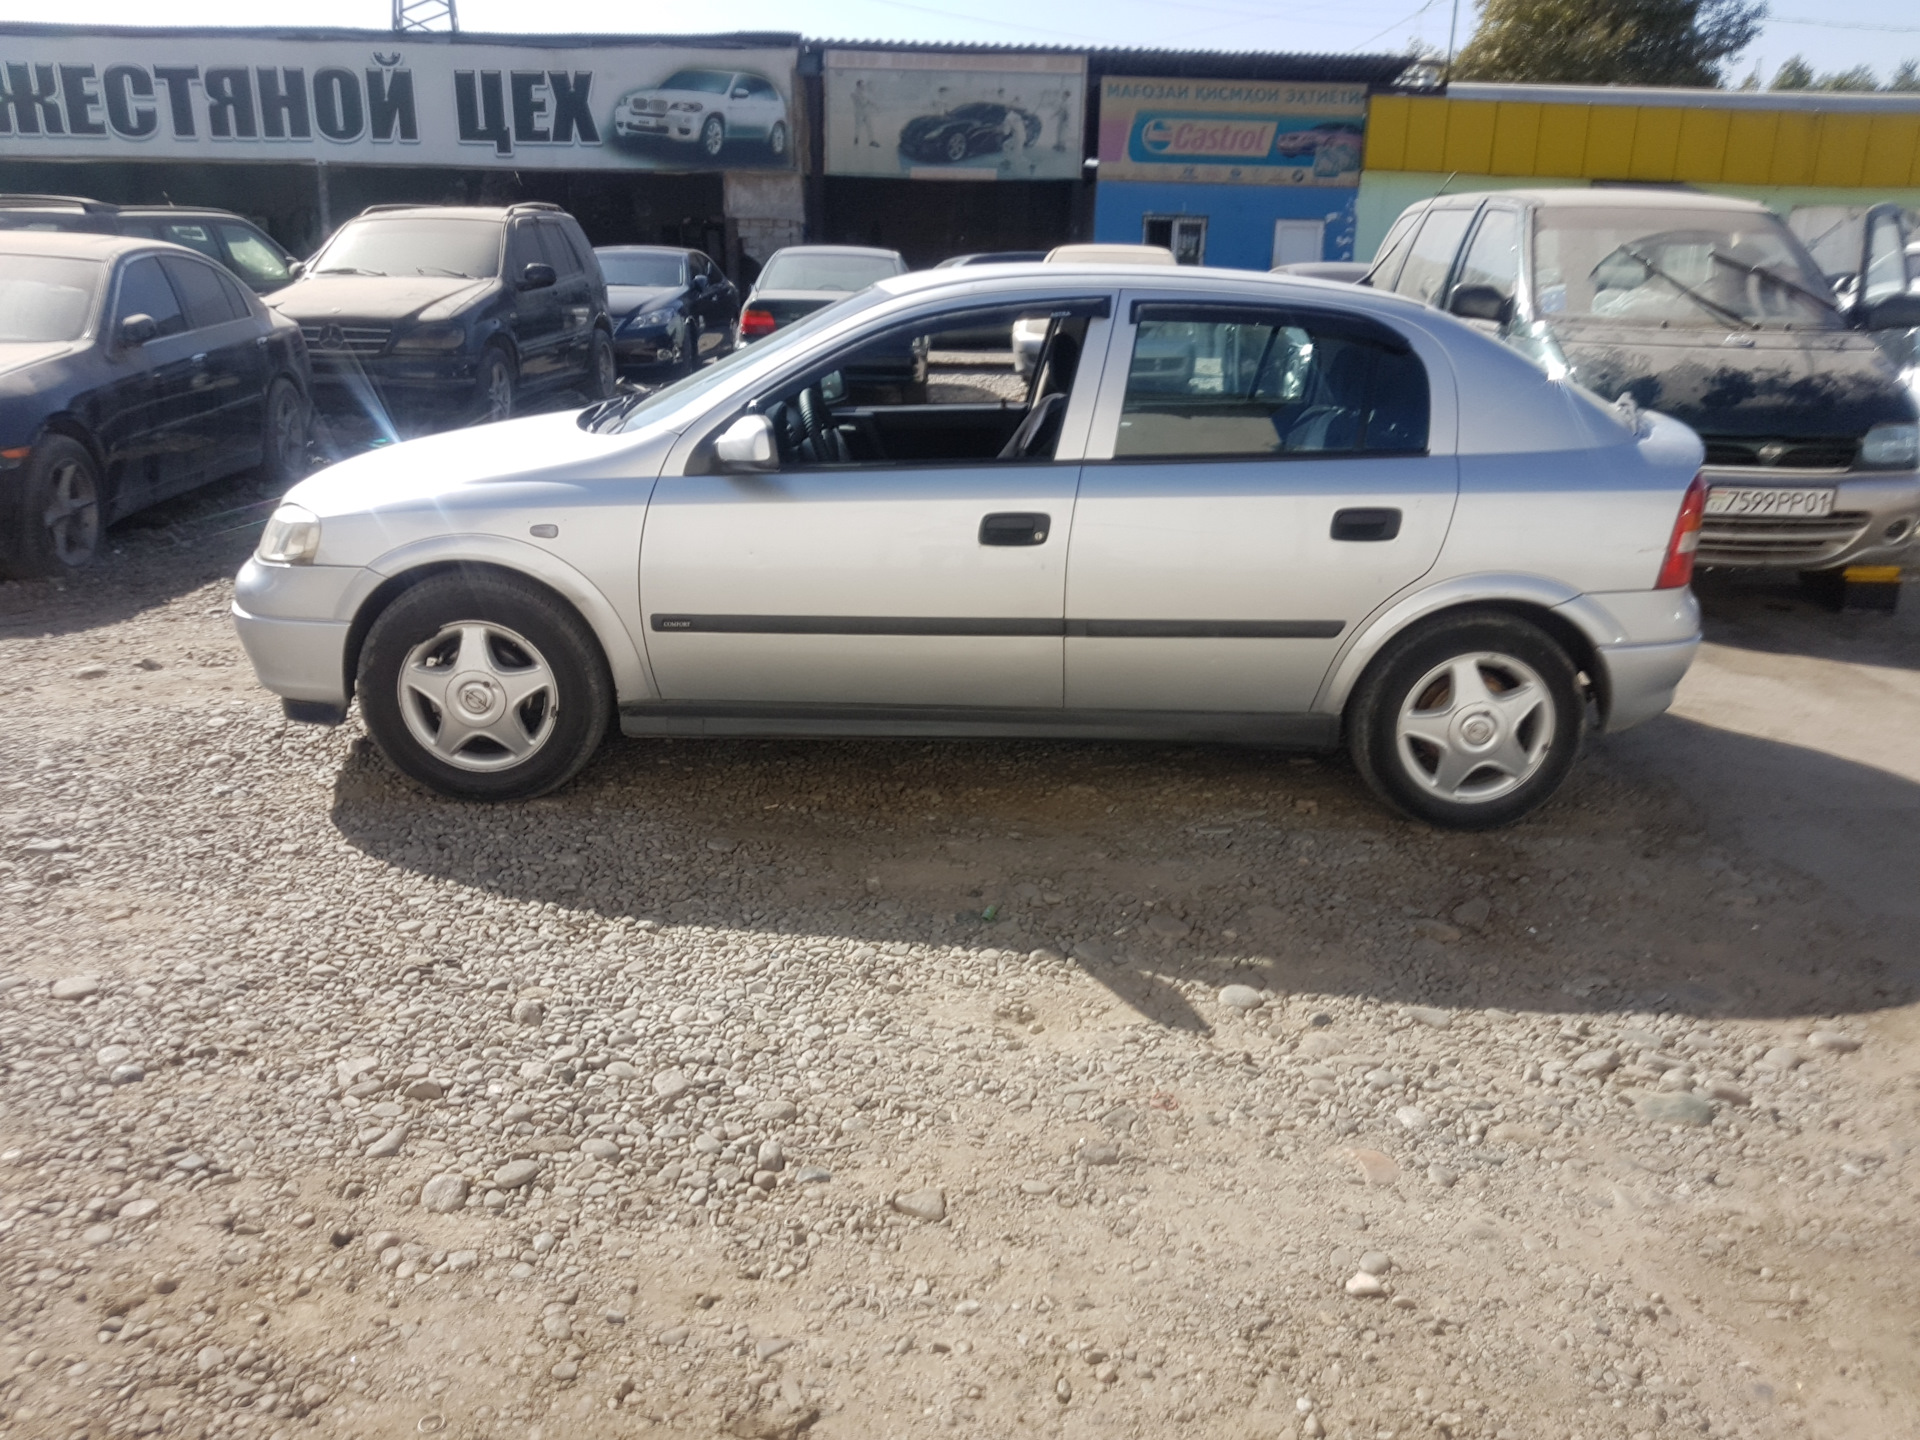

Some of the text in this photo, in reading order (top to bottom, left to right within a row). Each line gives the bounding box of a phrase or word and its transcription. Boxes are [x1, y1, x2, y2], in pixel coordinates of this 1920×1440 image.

[0, 51, 601, 154] ЖЕСТЯНОЙ ЦЕХ
[1172, 122, 1267, 151] Castrol
